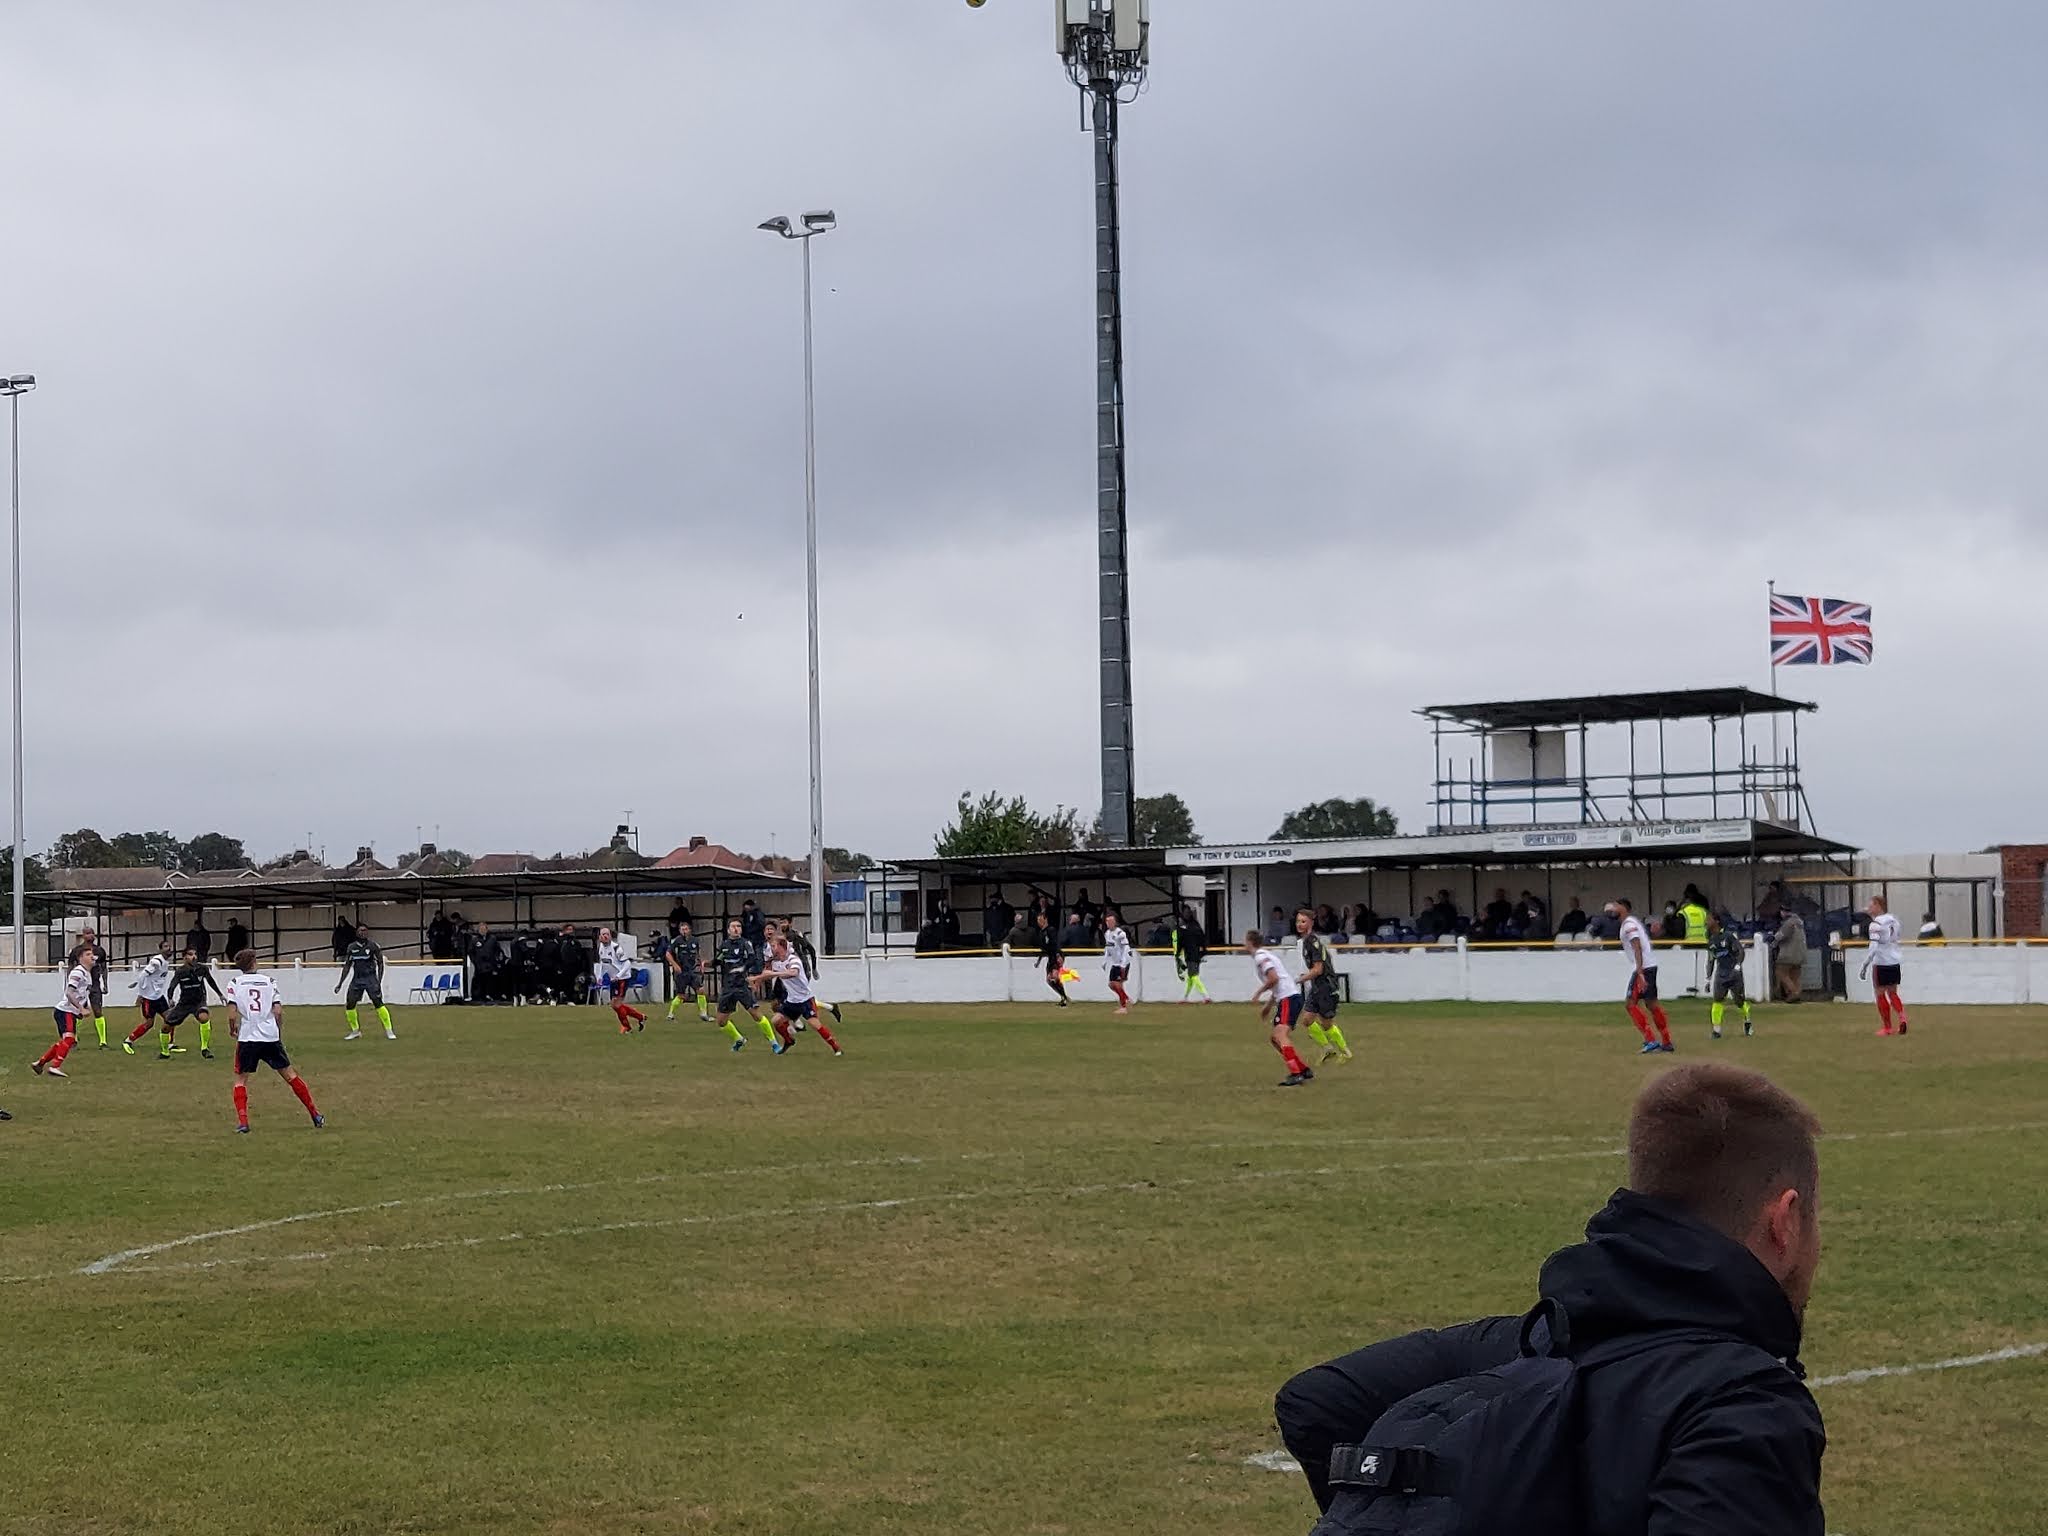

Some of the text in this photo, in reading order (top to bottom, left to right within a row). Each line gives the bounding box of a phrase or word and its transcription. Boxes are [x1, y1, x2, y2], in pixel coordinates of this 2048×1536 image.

[1636, 826, 1672, 838] Village
[1204, 852, 1222, 860] TONY
[1269, 849, 1292, 858] STAND
[249, 989, 261, 1012] 3
